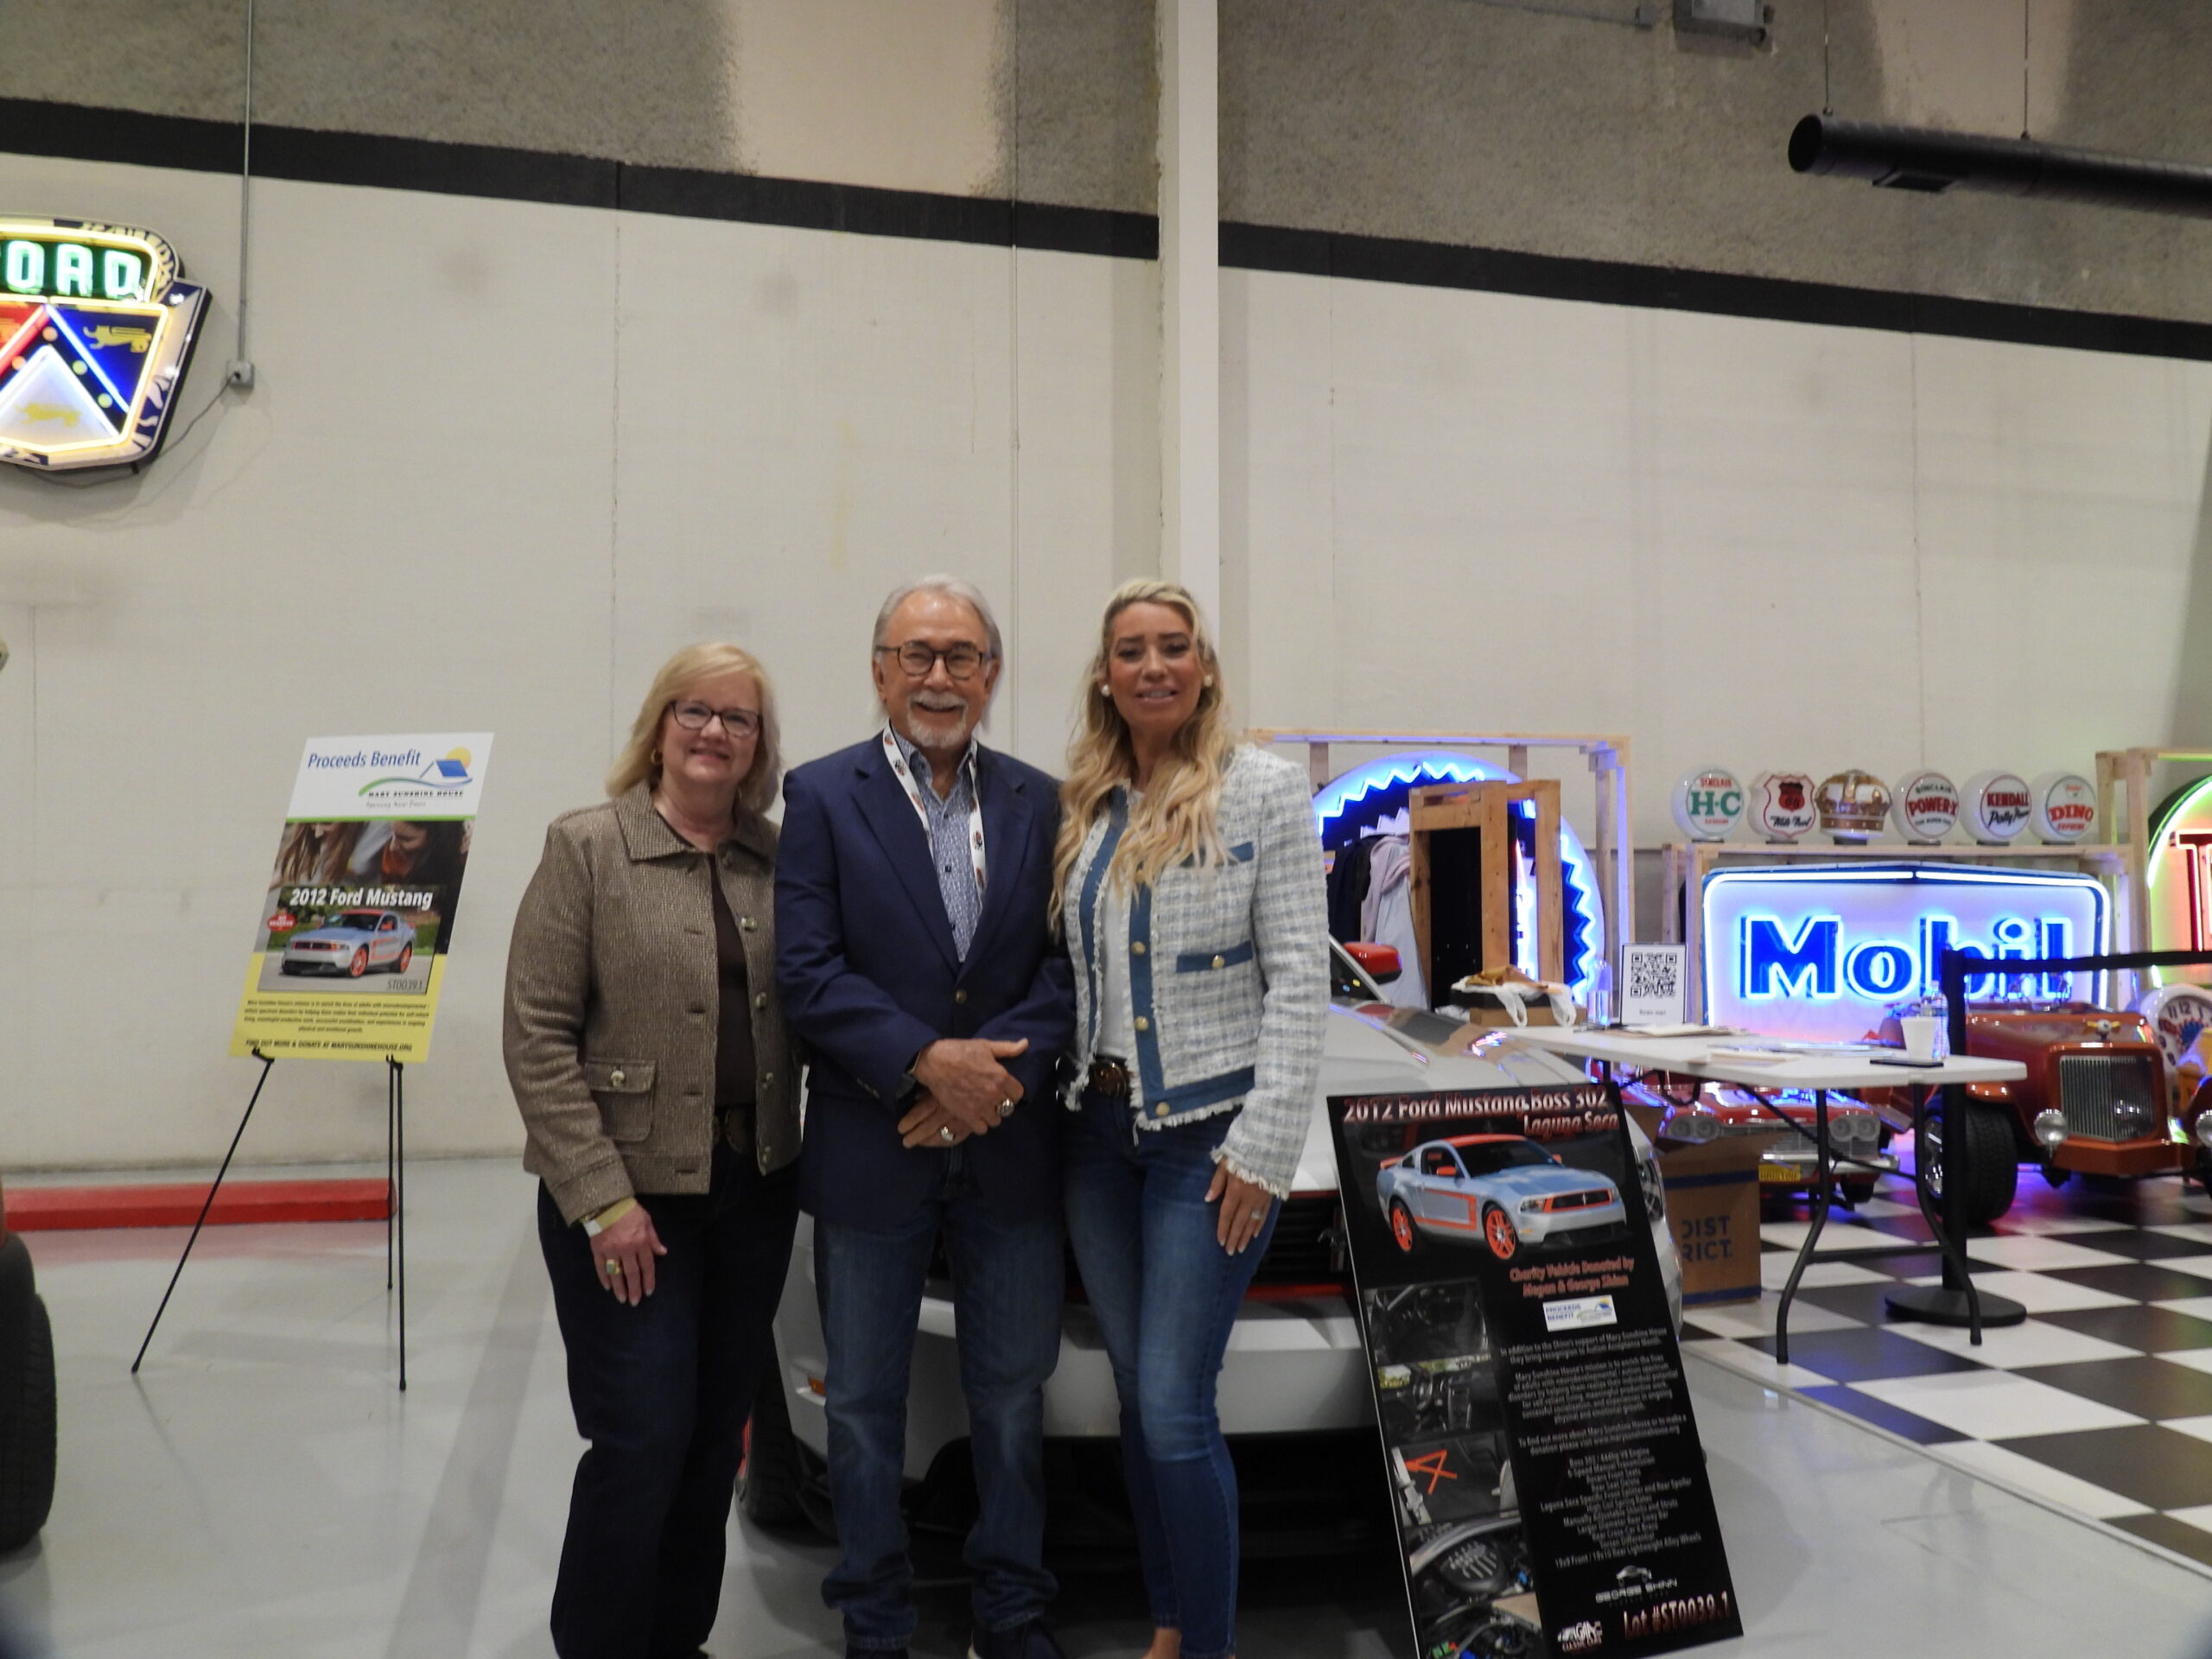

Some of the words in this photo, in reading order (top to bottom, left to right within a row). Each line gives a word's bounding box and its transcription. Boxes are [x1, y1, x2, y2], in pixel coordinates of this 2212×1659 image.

[308, 750, 367, 769] Proceeds
[371, 747, 421, 767] Benefit
[1987, 791, 2029, 807] KENDALL
[2049, 804, 2094, 823] DINO
[289, 888, 326, 906] 2012
[329, 887, 363, 906] Ford
[366, 888, 433, 910] Mustang
[1740, 914, 2073, 1000] Mobil
[1344, 1097, 1393, 1122] 2012
[1398, 1094, 1440, 1118] Ford
[1445, 1091, 1528, 1119] Mustang
[1530, 1089, 1571, 1111] Boss
[1575, 1085, 1607, 1109] 302
[1524, 1114, 1582, 1139] Laguna
[1585, 1110, 1619, 1131] Seca
[1510, 1266, 1545, 1282] Charity
[1581, 1256, 1622, 1273] Donated
[1622, 1255, 1635, 1272] by
[1558, 1279, 1566, 1294] &
[1567, 1278, 1601, 1294] George
[1605, 1332, 1621, 1343] Mary
[1624, 1609, 1647, 1639] Lot
